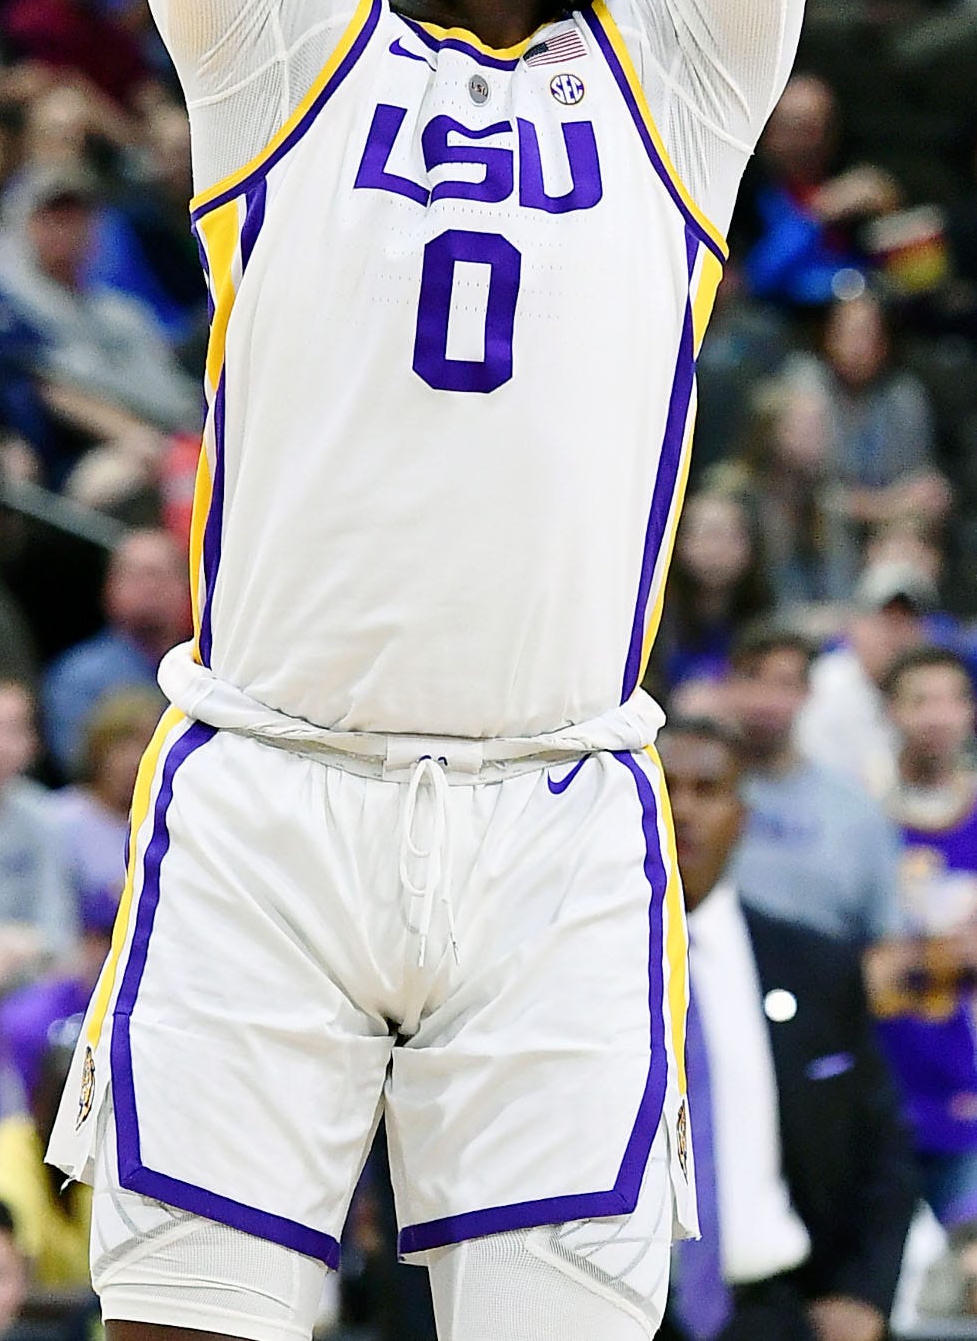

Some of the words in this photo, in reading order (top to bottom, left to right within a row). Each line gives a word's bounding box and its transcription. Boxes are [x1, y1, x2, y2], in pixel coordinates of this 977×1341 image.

[549, 73, 585, 106] SEC
[353, 103, 603, 214] LSU
[412, 228, 522, 394] 0
